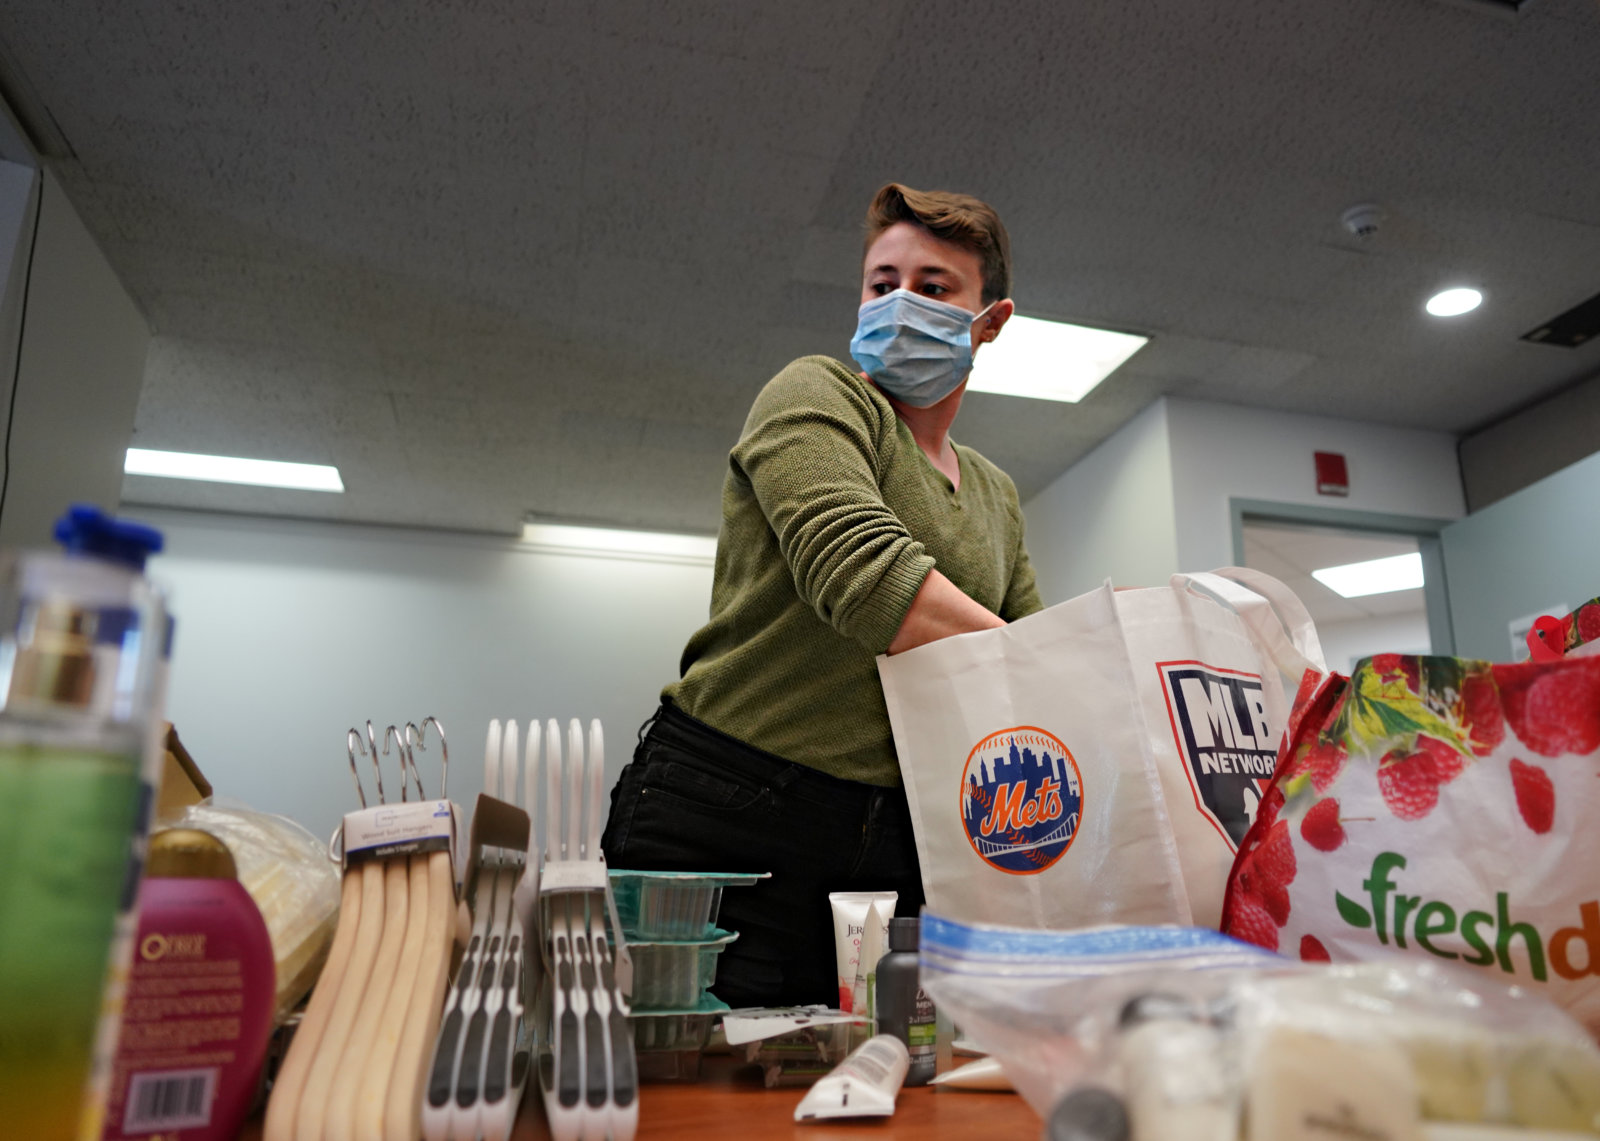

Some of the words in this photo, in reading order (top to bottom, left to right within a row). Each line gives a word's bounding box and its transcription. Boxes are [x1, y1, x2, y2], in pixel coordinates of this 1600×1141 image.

[1179, 678, 1277, 750] MLB
[1199, 752, 1277, 775] NETWOR
[980, 776, 1063, 837] Mets
